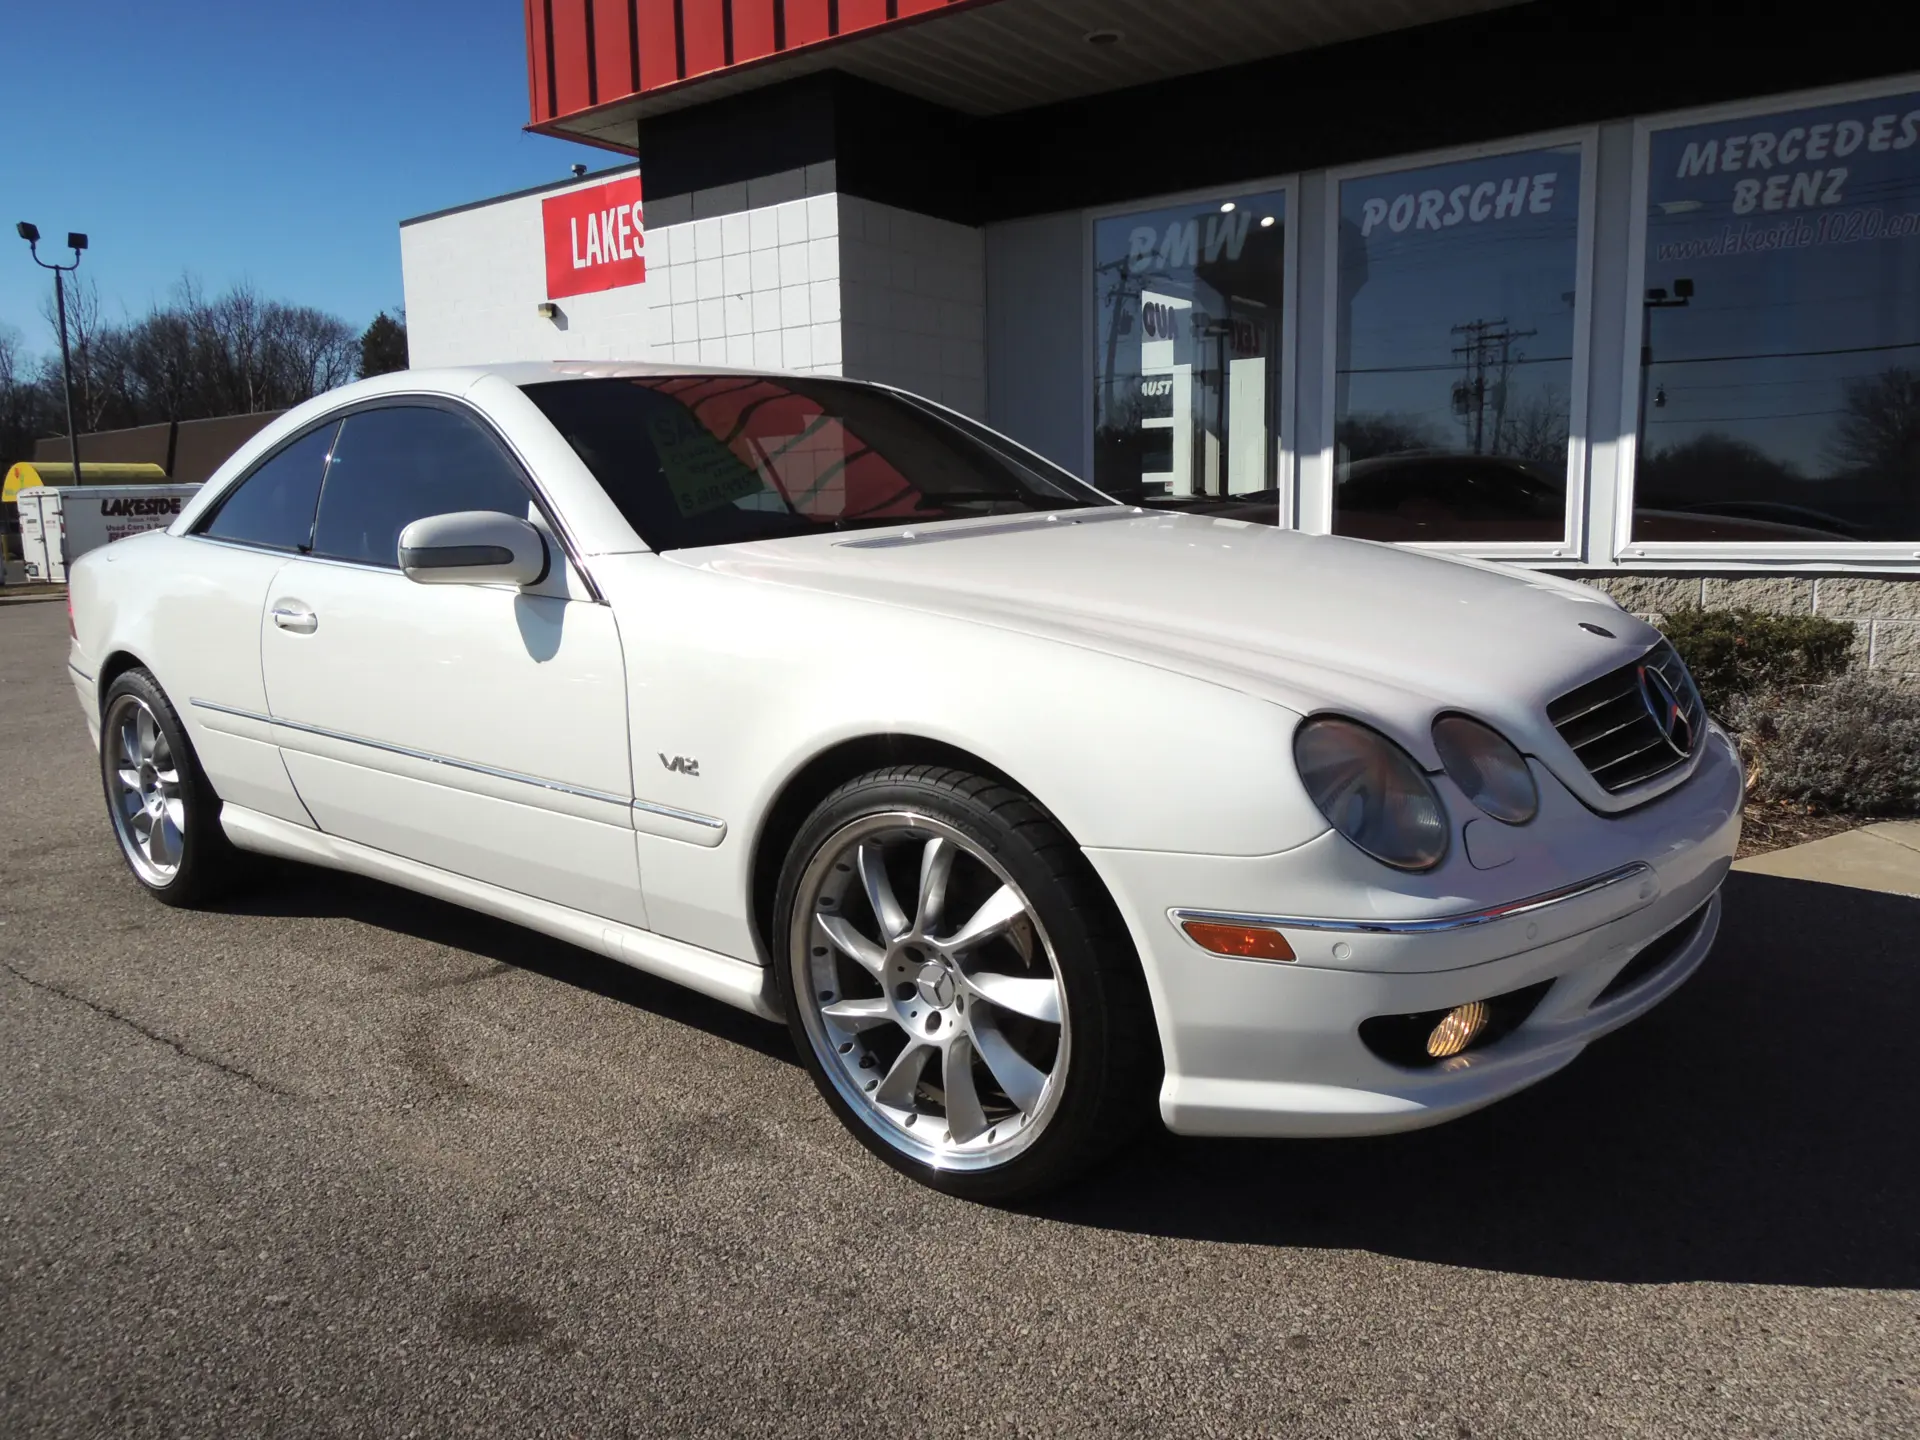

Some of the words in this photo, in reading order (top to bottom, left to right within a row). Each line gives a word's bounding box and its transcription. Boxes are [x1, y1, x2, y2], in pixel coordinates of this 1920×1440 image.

[1676, 109, 1920, 178] MERCEDES
[1361, 172, 1558, 237] PORSCHE
[1732, 167, 1848, 215] BENZ
[571, 200, 645, 269] LAKES
[1129, 211, 1250, 273] BMW
[101, 498, 181, 516] LAKESIDE
[657, 752, 699, 776] V12
